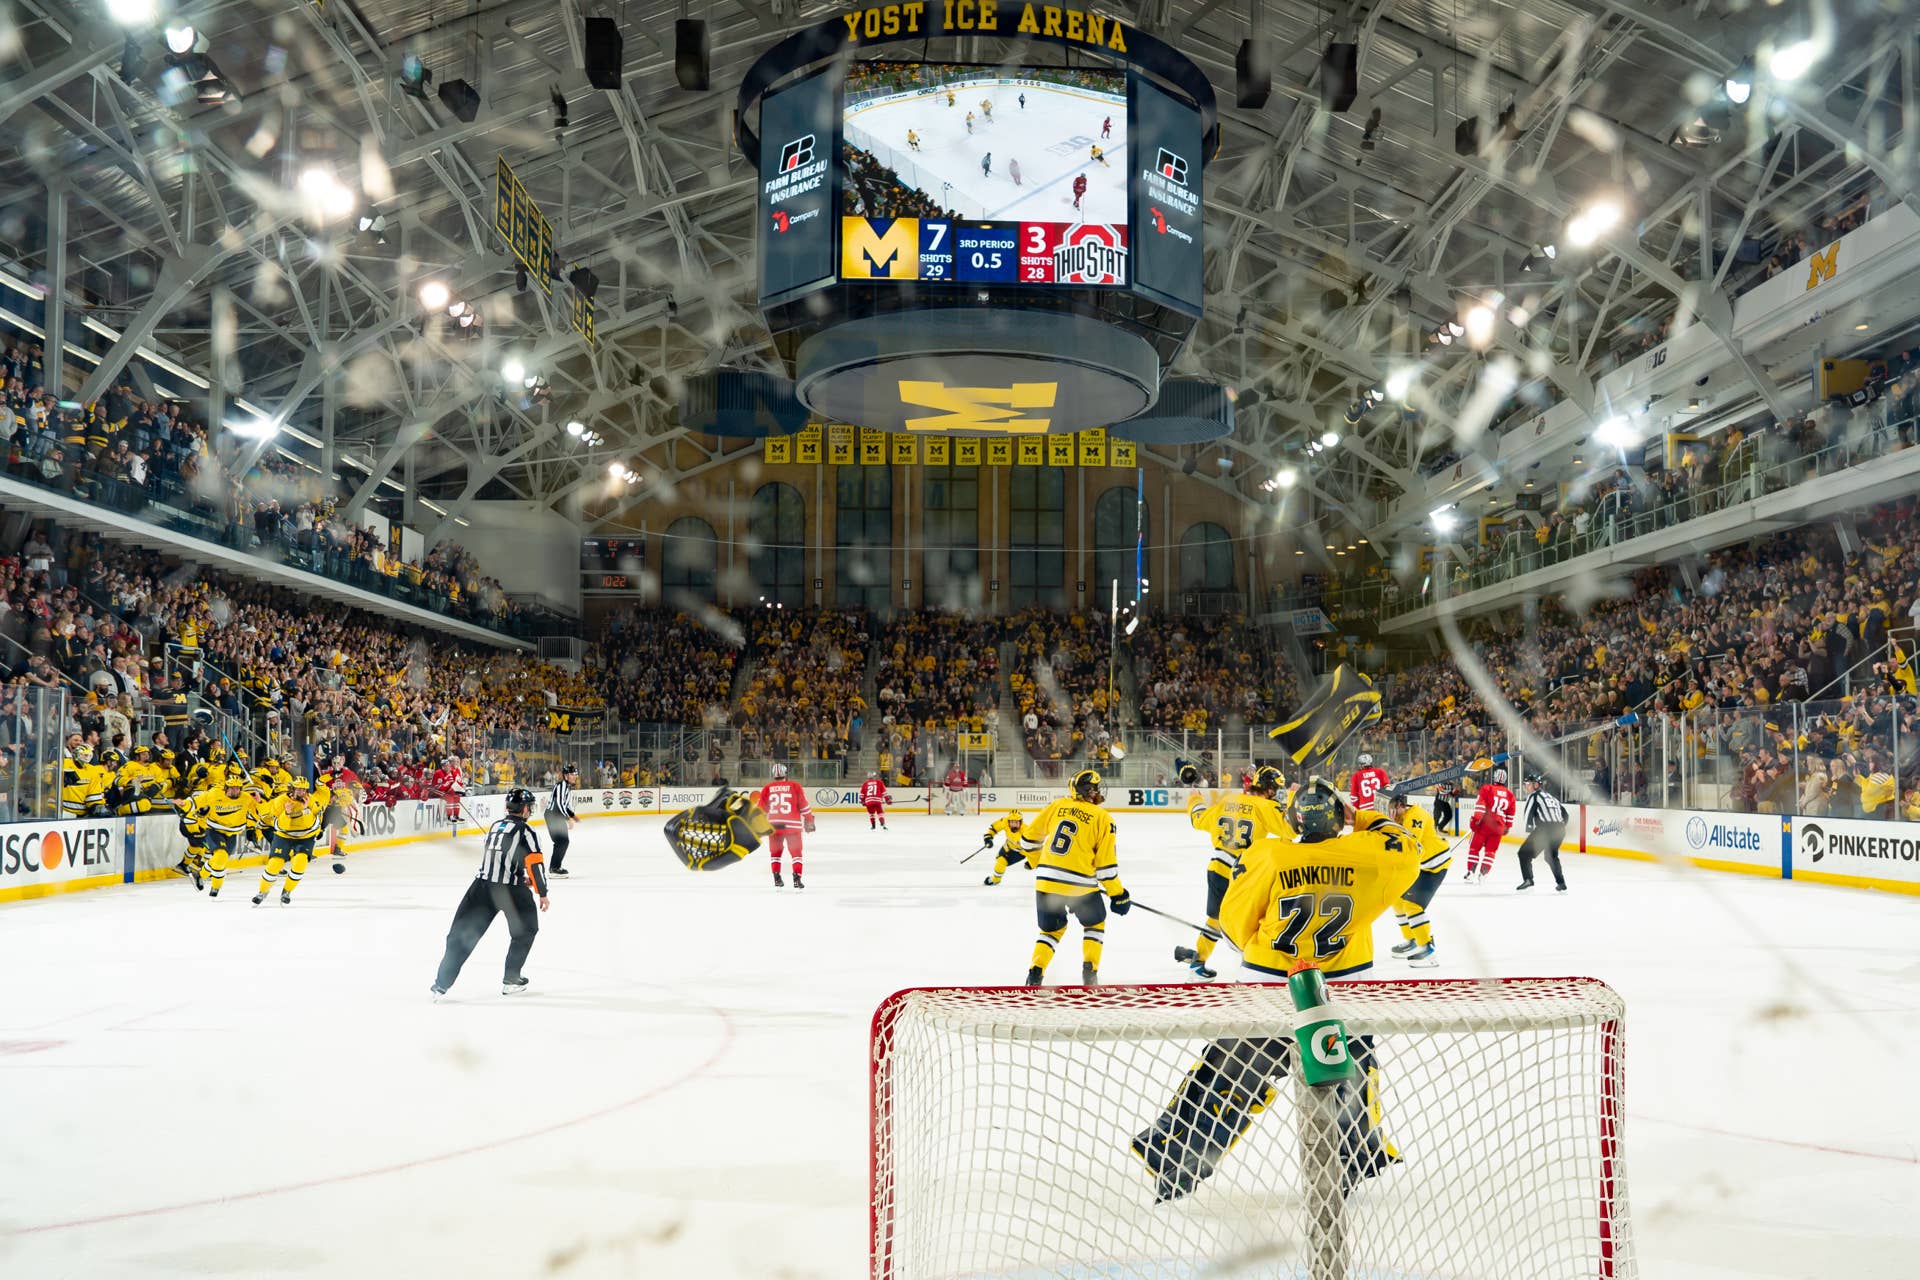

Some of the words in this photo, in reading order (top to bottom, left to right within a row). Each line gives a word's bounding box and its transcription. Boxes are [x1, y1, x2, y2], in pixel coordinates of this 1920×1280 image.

[843, 2, 924, 42] YOST
[943, 0, 998, 30] ICE
[1017, 3, 1128, 53] ARENA
[765, 174, 790, 194] FARM
[790, 159, 828, 184] BUREAU
[770, 175, 822, 205] INSURANCE
[1143, 169, 1167, 190] FARM
[1167, 181, 1199, 206] BUREAU
[1148, 186, 1194, 217] INSURANCE
[789, 208, 820, 225] Company
[927, 224, 948, 250] 7
[1166, 224, 1193, 245] Company
[960, 240, 978, 248] 3RD
[980, 240, 1015, 249] PERIOD
[1027, 227, 1047, 254] 3
[920, 254, 952, 263] SHOTS
[971, 252, 1002, 269] 0.5
[1021, 256, 1053, 266] SHOTS
[926, 264, 944, 277] 29
[1027, 267, 1045, 280] 28
[772, 444, 784, 453] M
[803, 444, 816, 453] M
[835, 445, 848, 454] M
[866, 445, 879, 454] M
[898, 445, 911, 454] M
[930, 446, 943, 455] M
[961, 446, 975, 455] M
[993, 446, 1006, 455] M
[1024, 446, 1037, 455] M
[1055, 447, 1068, 456] M
[1086, 447, 1099, 456] M
[1117, 448, 1130, 457] M
[550, 711, 570, 731] M
[970, 735, 982, 744] M
[866, 785, 878, 796] 21
[1361, 777, 1380, 797] 63
[577, 796, 593, 804] RAM
[672, 794, 704, 803] ABBOTT
[1019, 793, 1047, 802] Hilton
[768, 793, 792, 815] 25
[1412, 819, 1422, 828] M
[1783, 822, 1791, 832] M
[1051, 819, 1078, 856] 6
[1217, 816, 1255, 850] 33
[1709, 824, 1761, 851] Allstate
[1279, 866, 1354, 890] IVANKOVIC
[1271, 893, 1355, 959] 72
[1310, 1023, 1348, 1066] G
